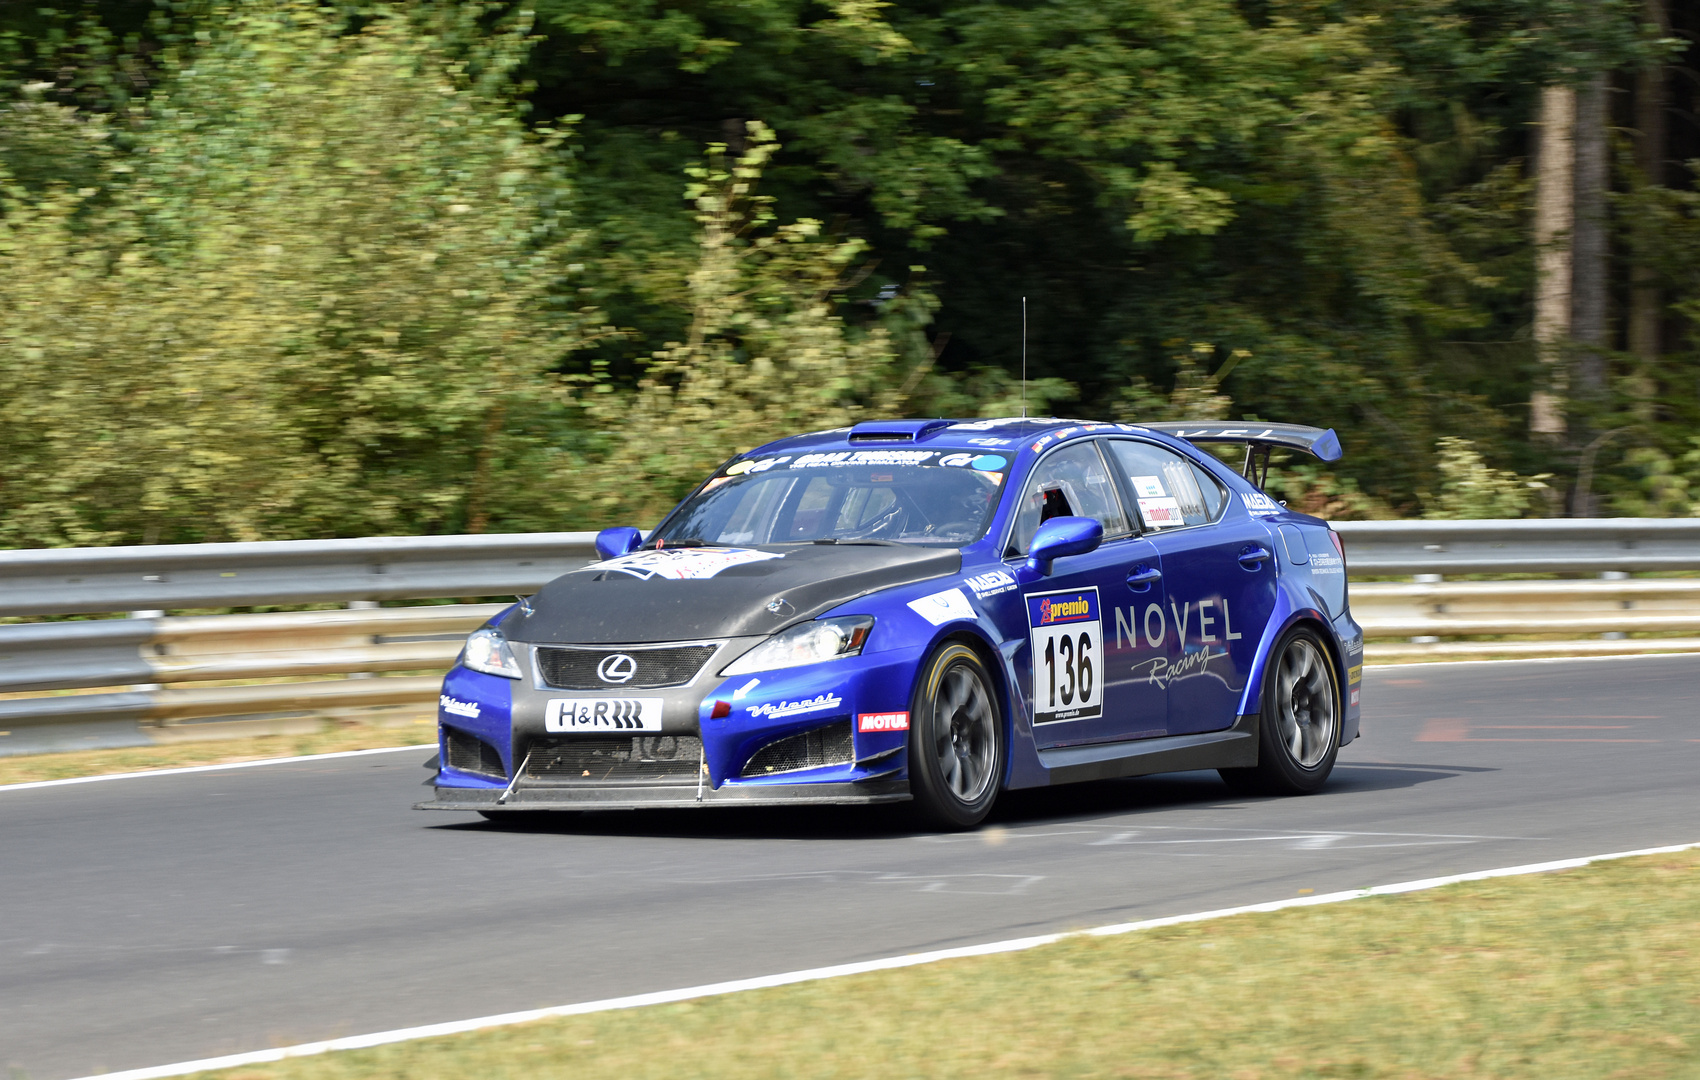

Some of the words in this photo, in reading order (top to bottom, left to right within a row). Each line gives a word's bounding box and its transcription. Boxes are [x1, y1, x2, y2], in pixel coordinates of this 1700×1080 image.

[1241, 493, 1276, 510] MAEDA
[963, 570, 1015, 593] MAEDA
[1050, 596, 1089, 622] premio
[1114, 599, 1242, 650] NOVEL
[1045, 631, 1093, 708] 136
[1131, 645, 1229, 690] Racing
[559, 701, 609, 727] H&R
[746, 693, 842, 718] Valenti
[861, 714, 908, 731] MOTUL
